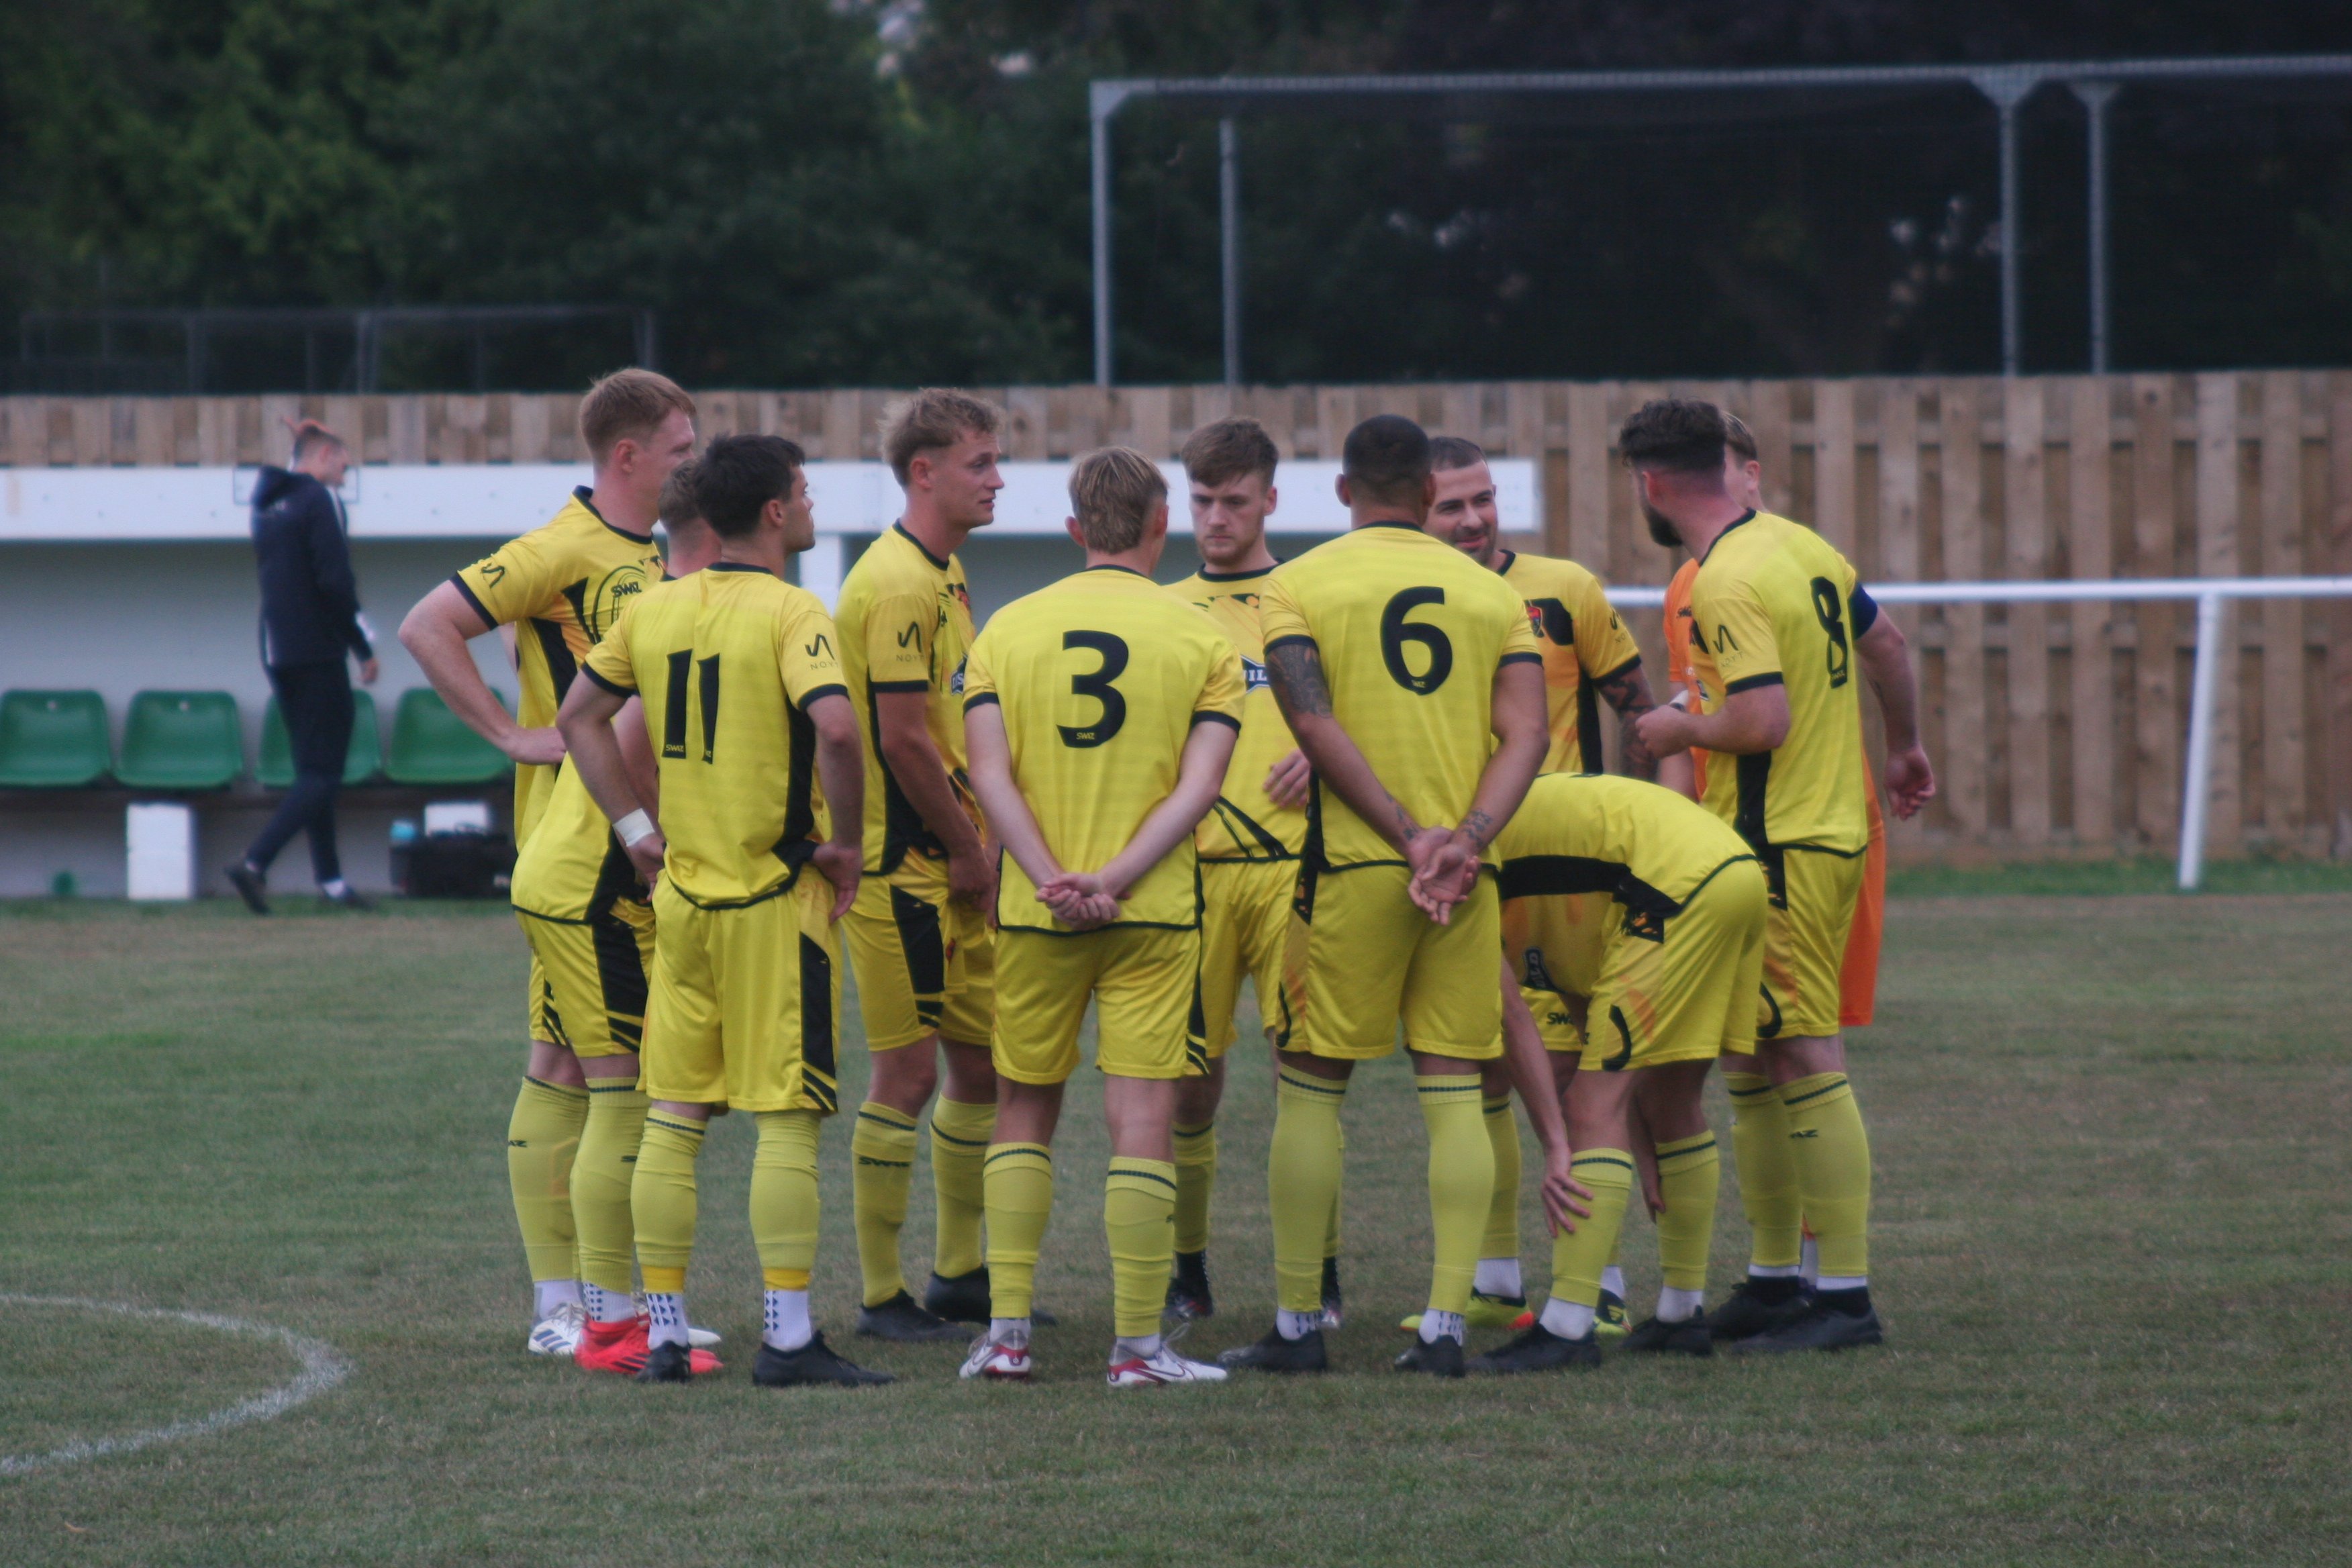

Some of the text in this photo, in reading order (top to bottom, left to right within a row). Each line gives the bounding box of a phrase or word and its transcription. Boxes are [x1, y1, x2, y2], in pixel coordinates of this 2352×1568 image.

[1056, 630, 1129, 748] 3
[1380, 586, 1453, 696] 6
[1810, 576, 1848, 689] 8
[661, 648, 720, 765] 11
